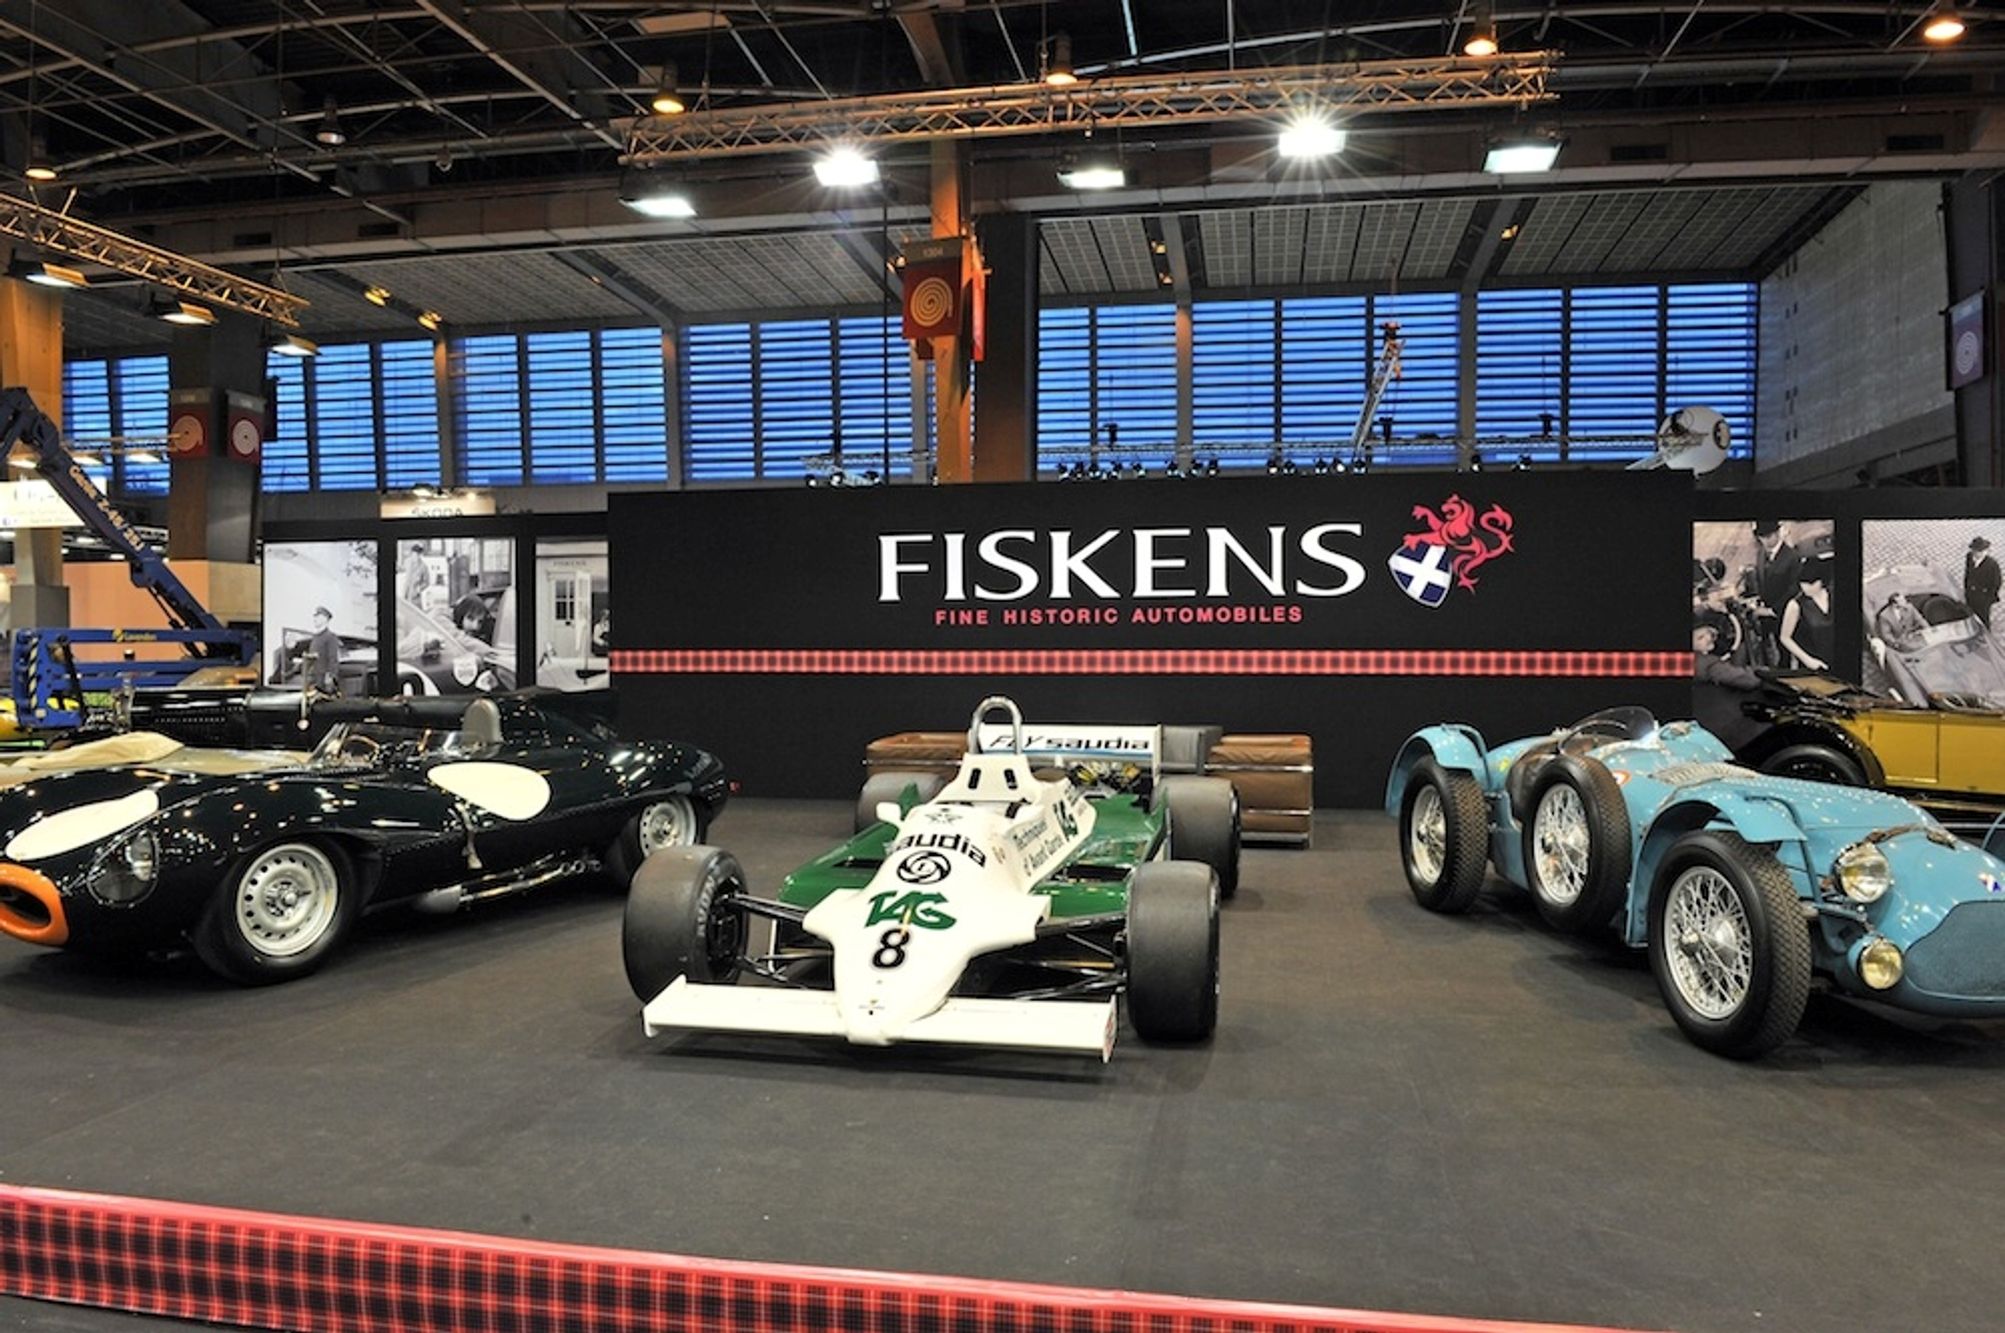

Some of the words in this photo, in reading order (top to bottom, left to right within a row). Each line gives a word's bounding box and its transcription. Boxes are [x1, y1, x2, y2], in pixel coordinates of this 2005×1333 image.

[878, 523, 1366, 601] FISKENS
[935, 610, 988, 625] FINE
[1003, 608, 1117, 625] HISTORIC
[1132, 606, 1302, 624] AUTOMOBILES
[1045, 736, 1150, 750] saudia
[894, 833, 987, 869] audia
[864, 889, 958, 930] TAG
[872, 927, 911, 969] 8
